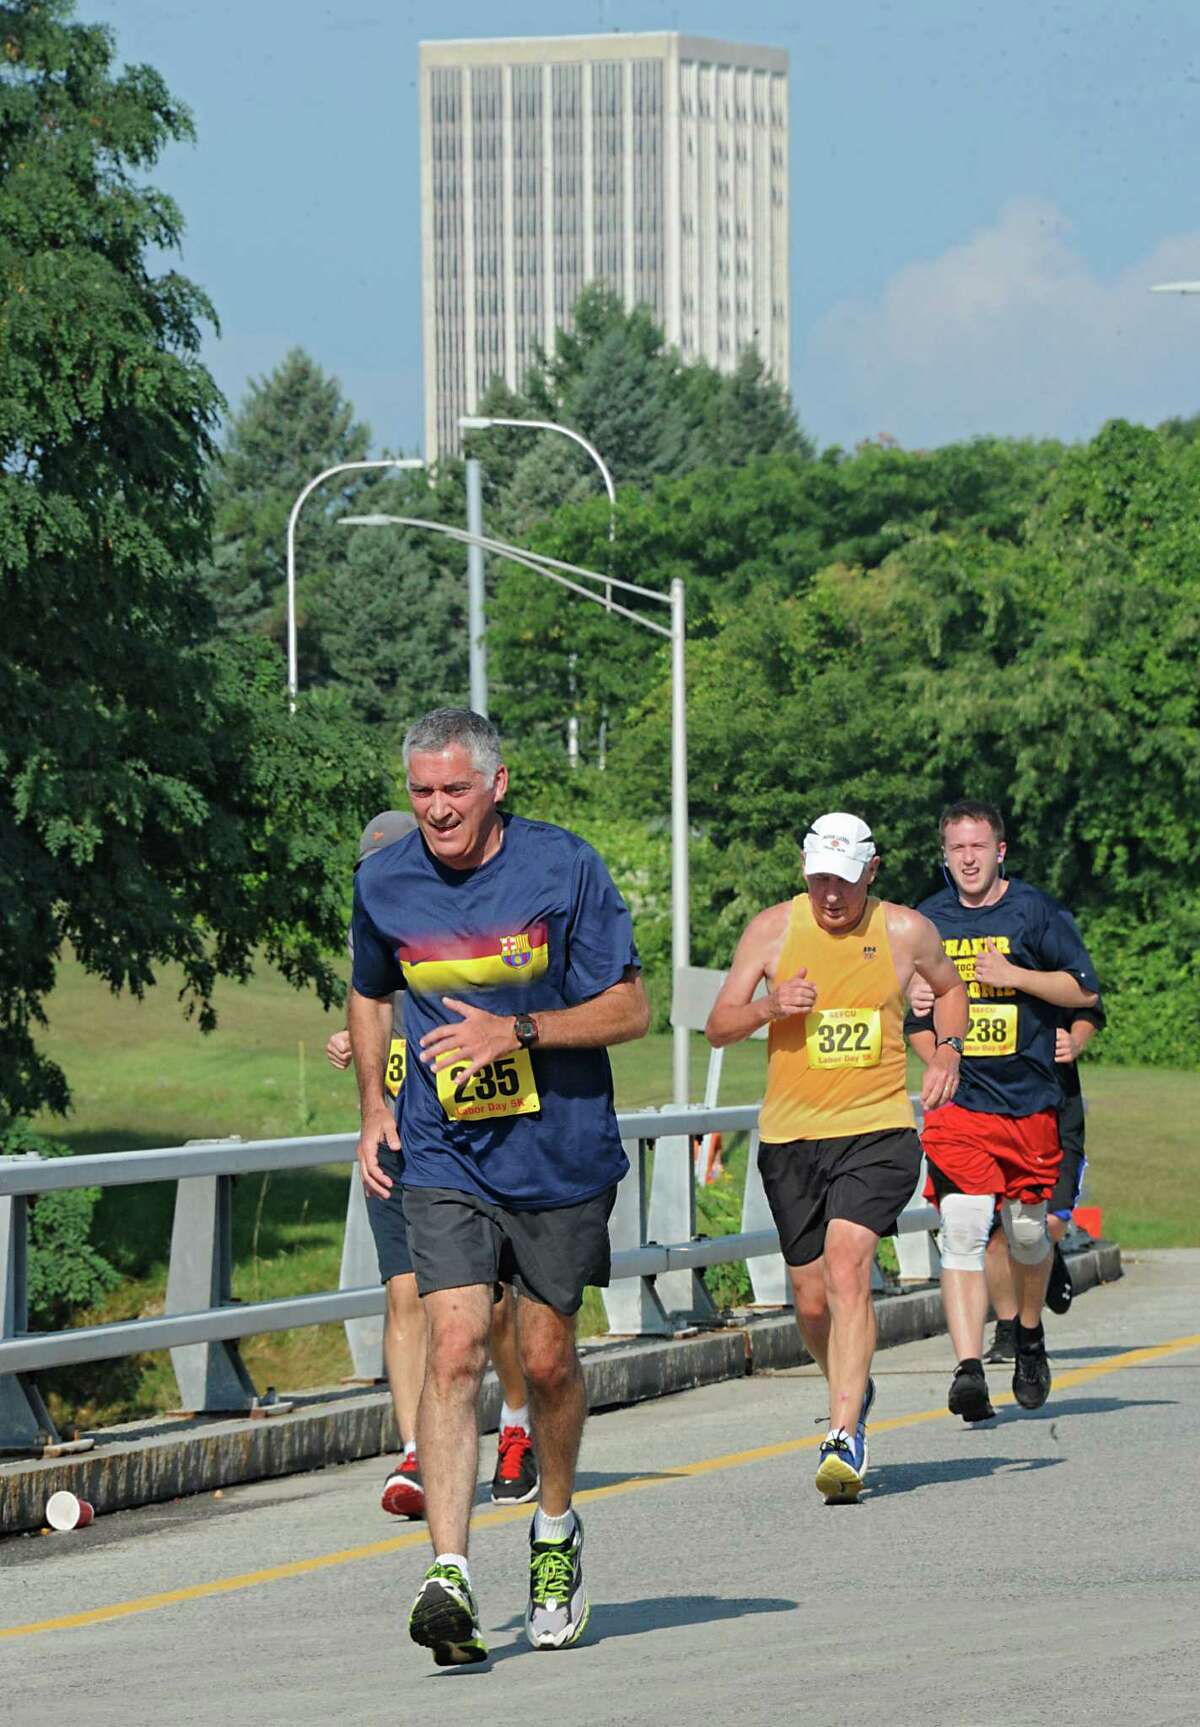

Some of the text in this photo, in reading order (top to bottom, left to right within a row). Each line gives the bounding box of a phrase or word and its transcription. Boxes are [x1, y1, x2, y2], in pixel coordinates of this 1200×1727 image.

[942, 936, 1011, 956] HAKER
[818, 1022, 871, 1053] 322
[965, 1018, 1007, 1043] 238
[844, 1055, 860, 1064] Day
[450, 1058, 520, 1103] 235
[456, 1098, 525, 1117] Labor Day 5K
